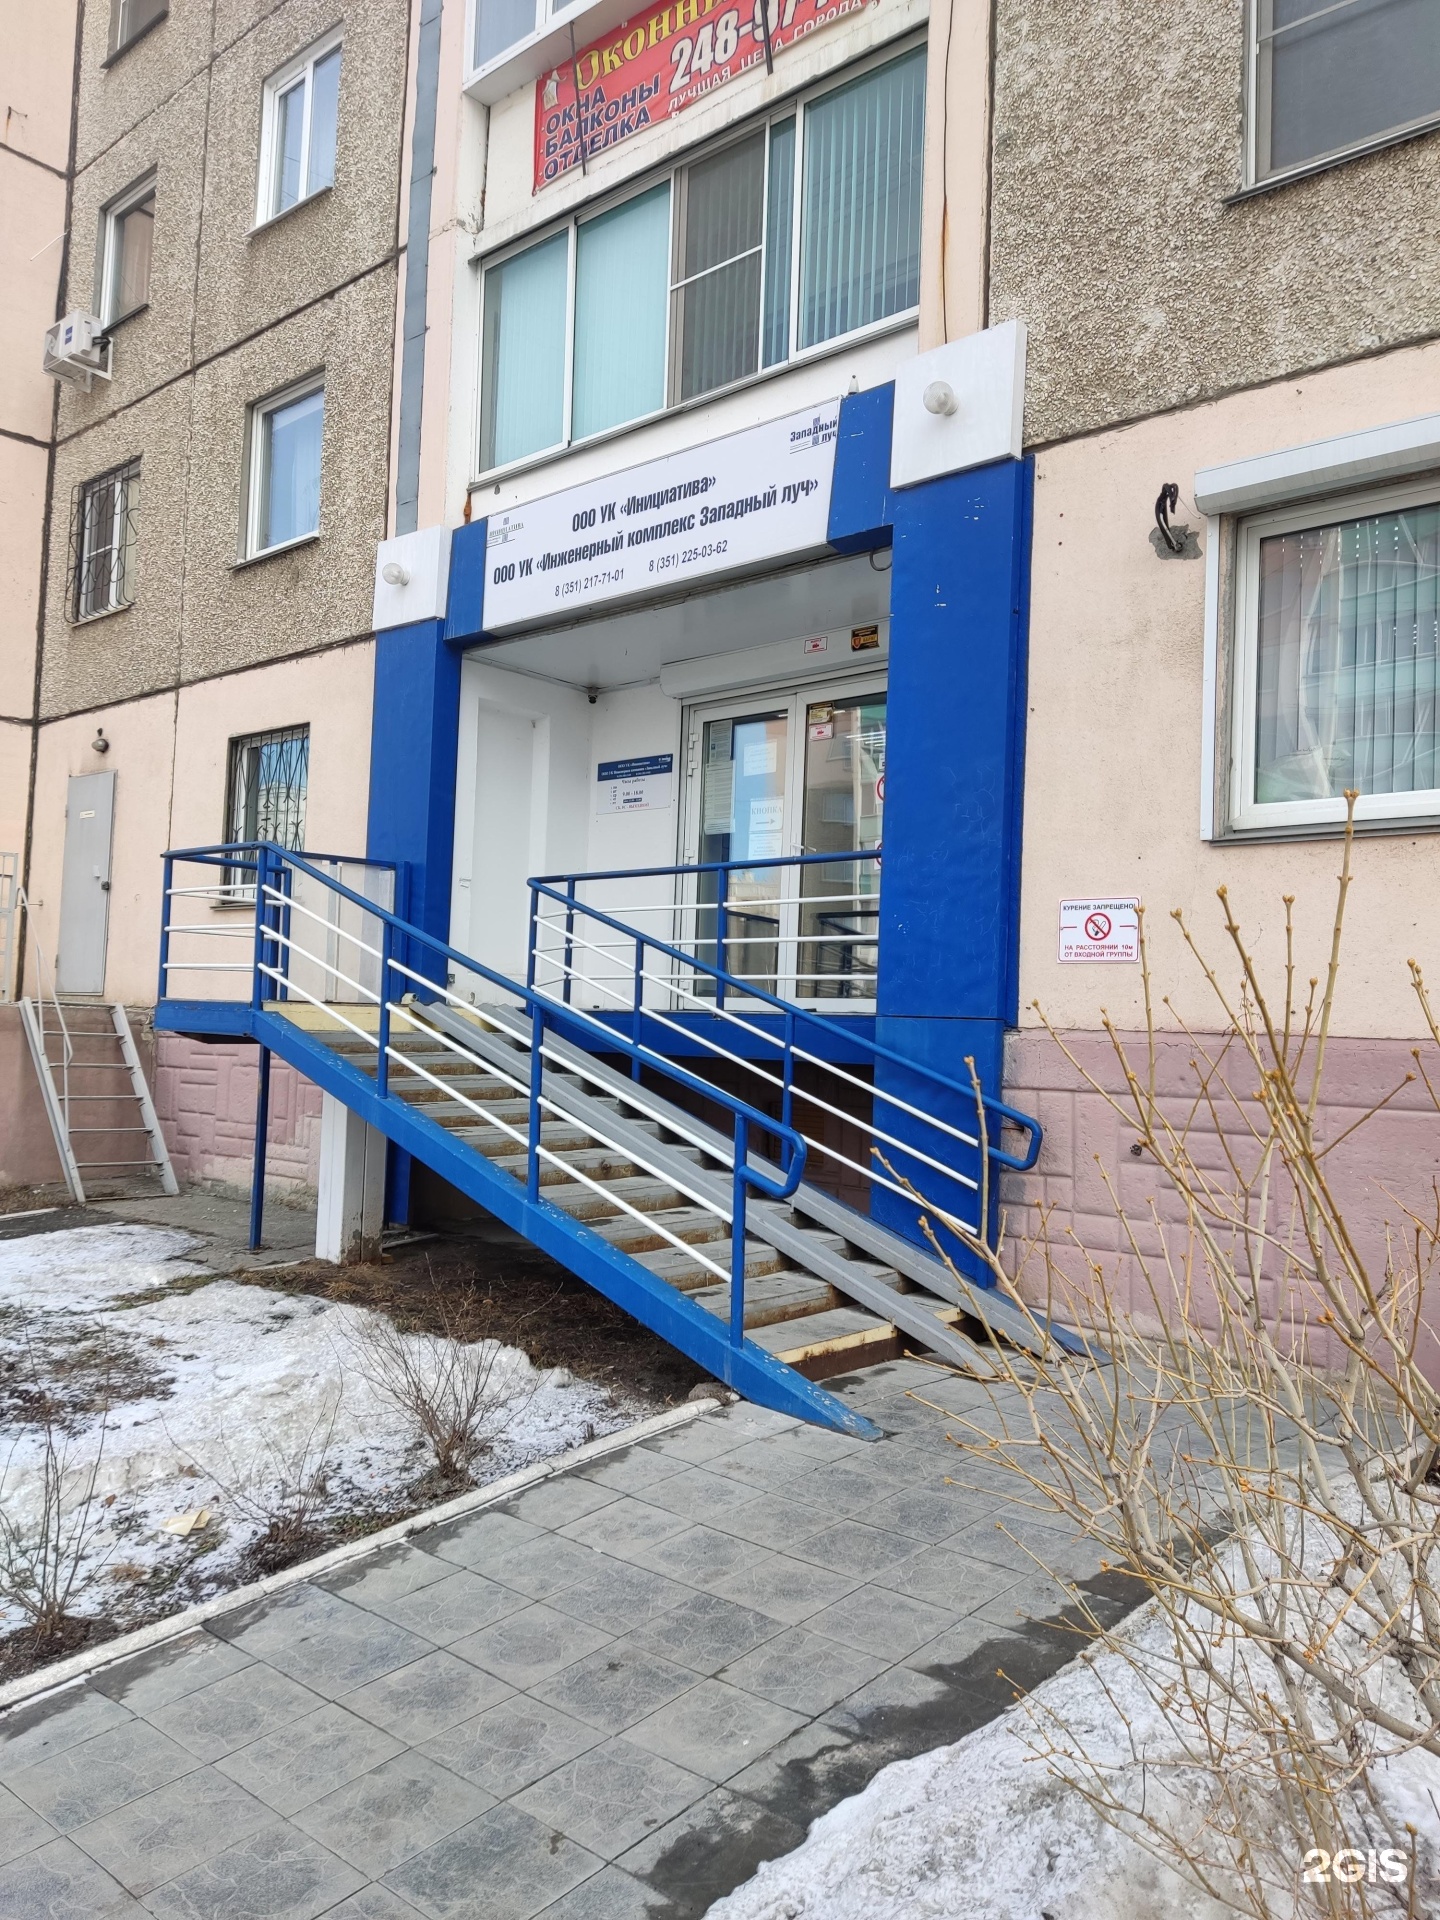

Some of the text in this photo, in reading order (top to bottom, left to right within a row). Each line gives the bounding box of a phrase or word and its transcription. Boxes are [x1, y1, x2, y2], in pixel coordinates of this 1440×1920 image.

[545, 84, 607, 136] ОКНА
[668, 65, 731, 112] ЛУЧШАЯ
[545, 72, 661, 159] БАЛКОНЫ
[544, 104, 652, 181] ОТДЕЛКА
[790, 415, 838, 442] Западный
[572, 475, 717, 532] ООО УК «Инициатива»
[493, 562, 515, 585] ООО
[519, 557, 534, 578] УК
[536, 530, 624, 571] «Инженерный
[627, 513, 696, 547] комплекс
[699, 483, 777, 527] Западный
[781, 478, 819, 504] луч»
[648, 539, 728, 573] 8 (351) 225-03-62
[555, 568, 625, 598] 8 (351) 217-71-01
[751, 805, 783, 816] КНОПКА
[1074, 950, 1105, 958] ВХОДНОЙ
